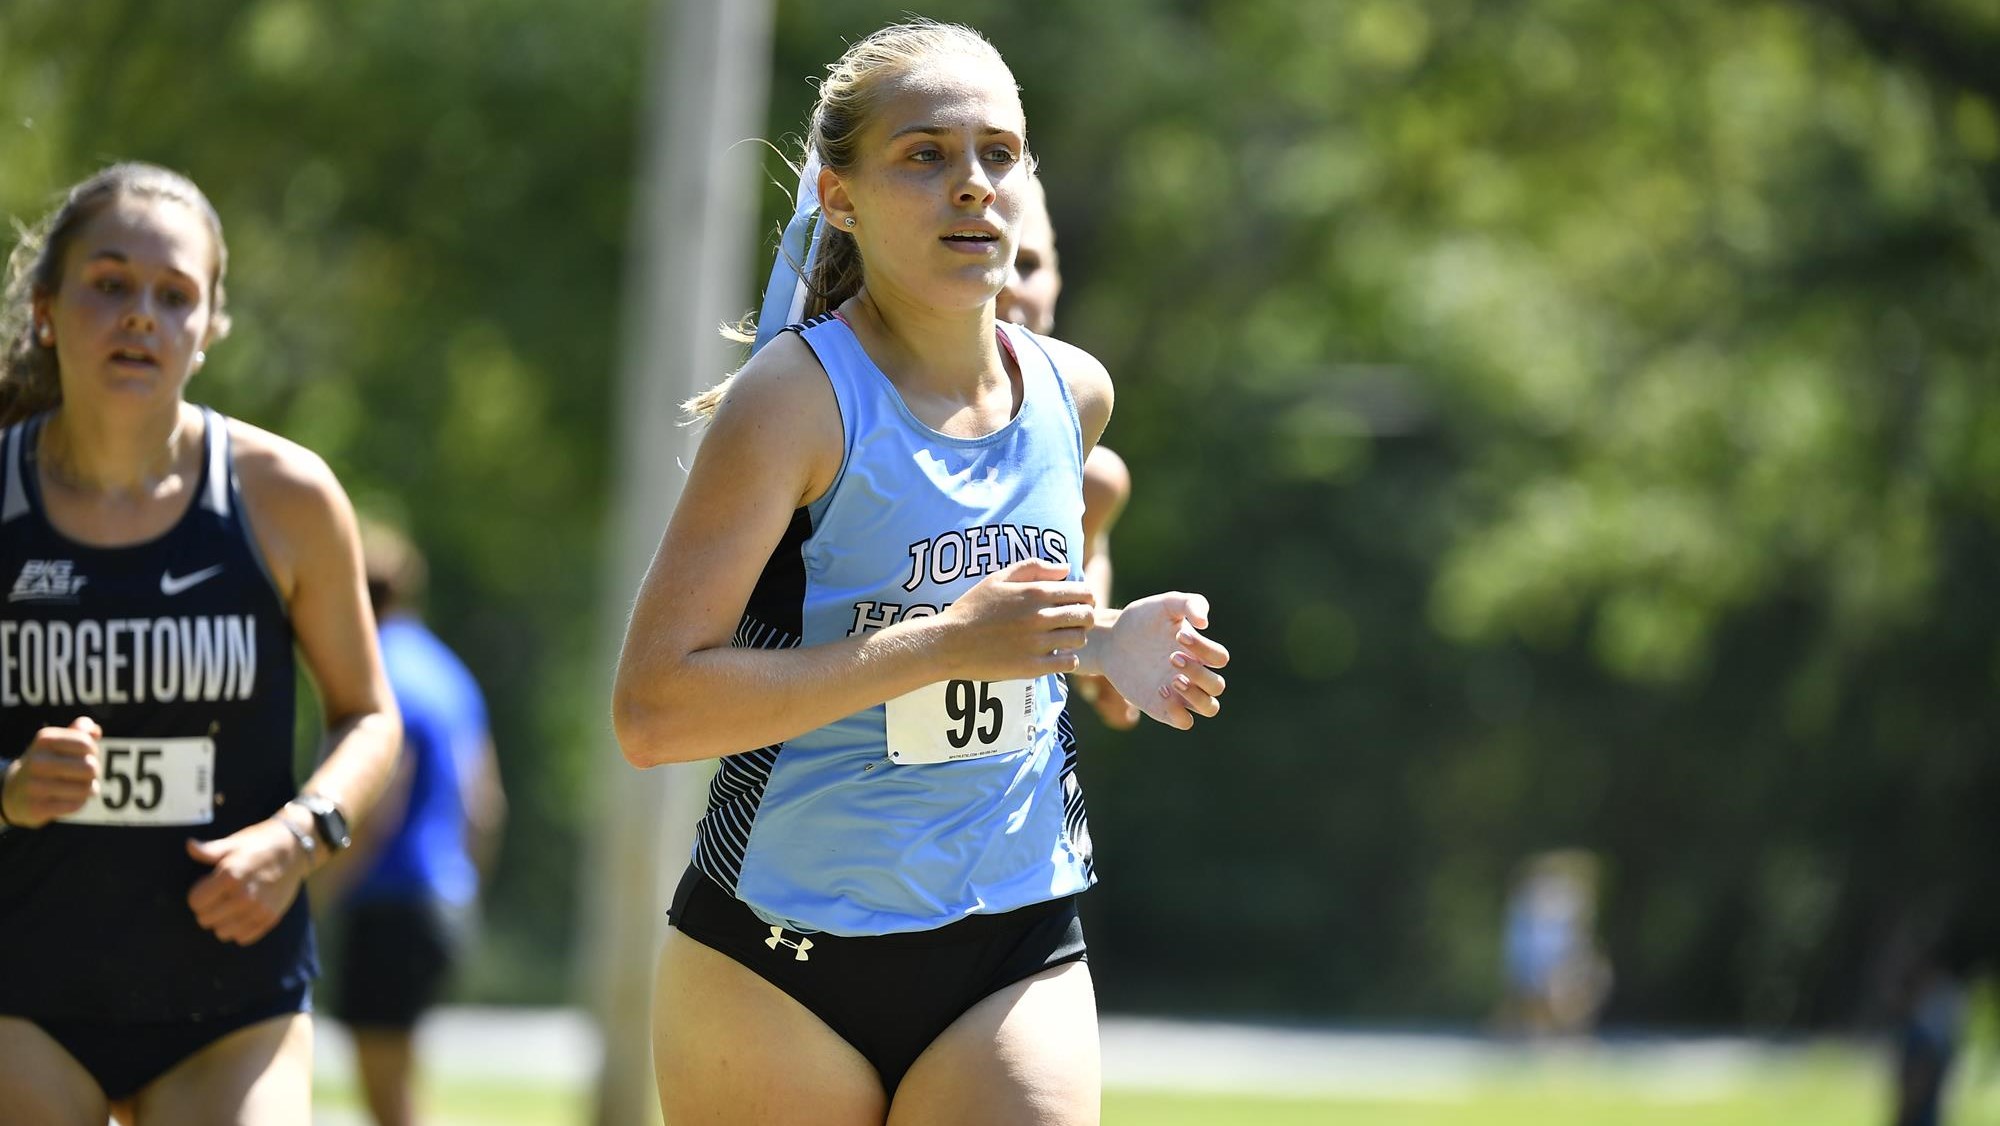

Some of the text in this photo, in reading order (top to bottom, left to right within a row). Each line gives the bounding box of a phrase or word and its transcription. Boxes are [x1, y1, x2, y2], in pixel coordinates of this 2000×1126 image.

[13, 575, 88, 595] EAST
[902, 524, 1068, 592] JOHNS
[0, 614, 256, 706] EORGETOWN
[945, 679, 1003, 748] 95
[103, 748, 164, 810] 55
